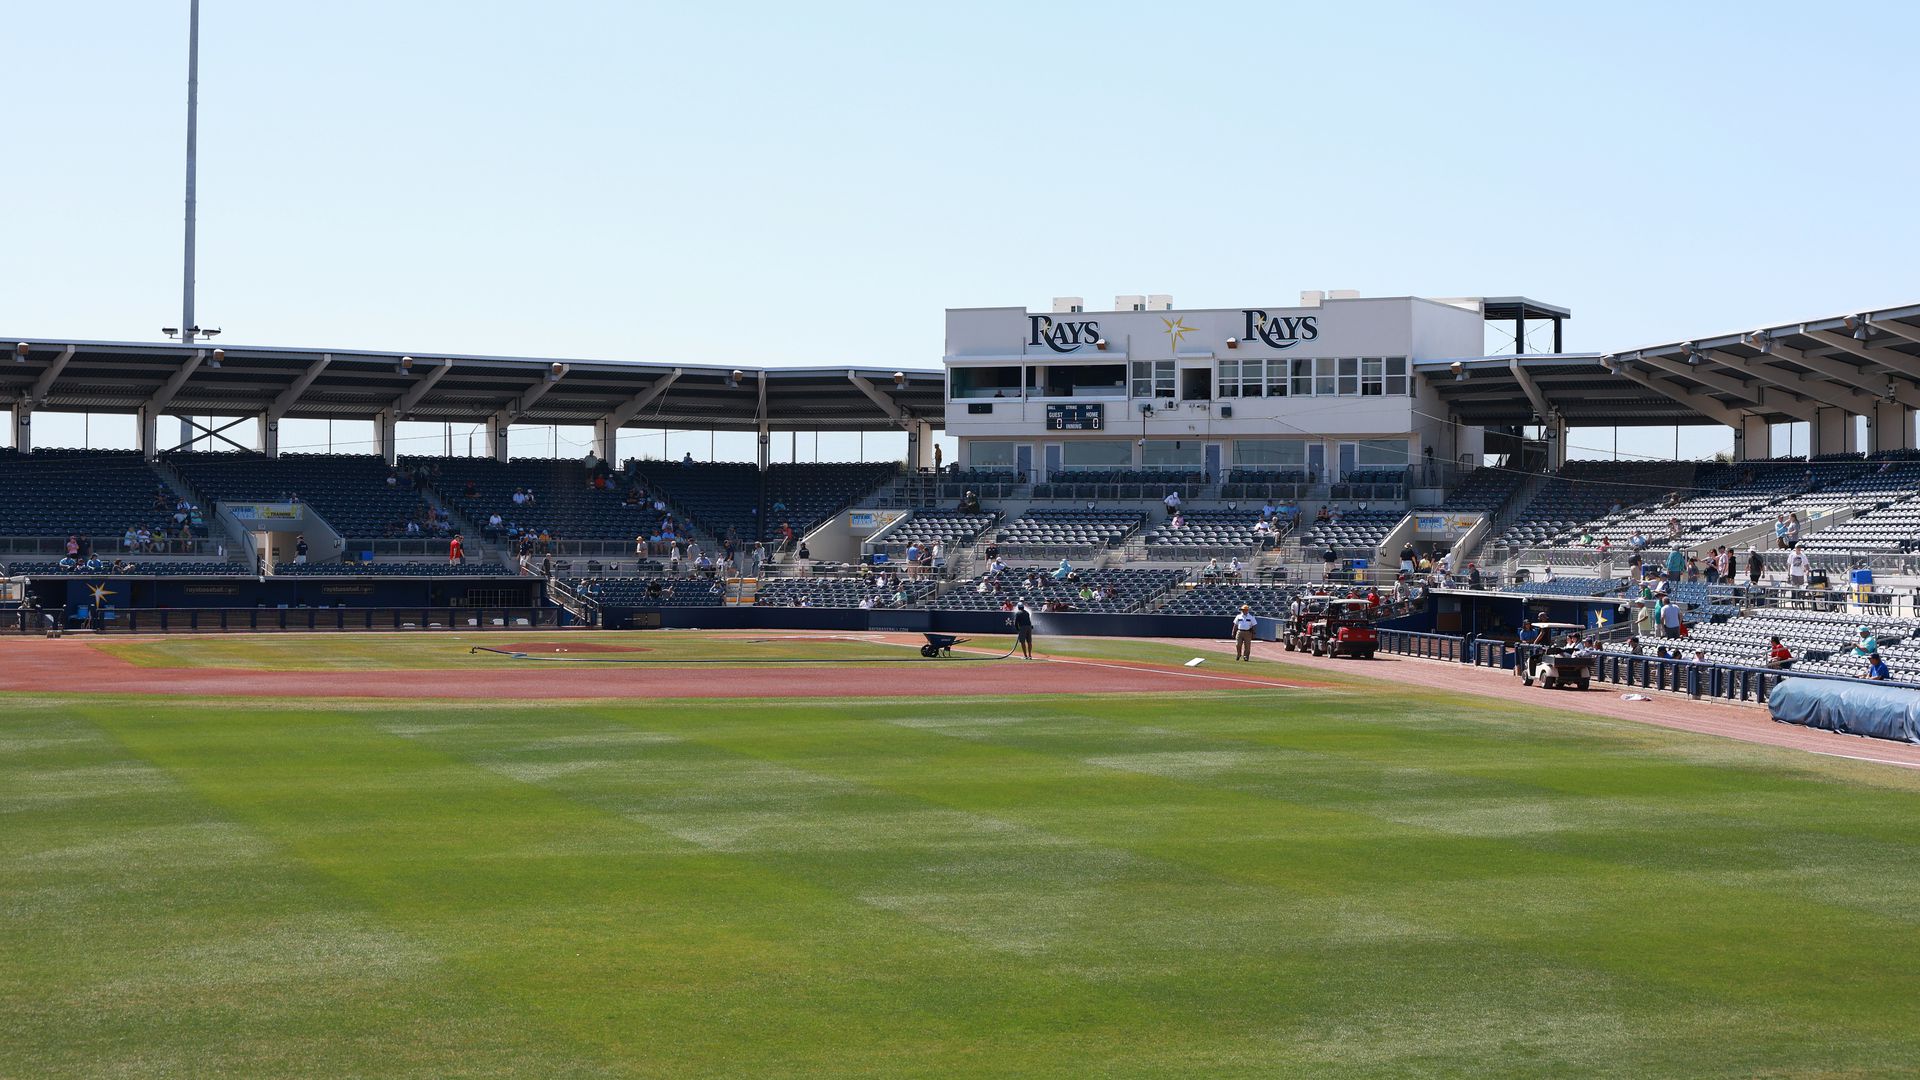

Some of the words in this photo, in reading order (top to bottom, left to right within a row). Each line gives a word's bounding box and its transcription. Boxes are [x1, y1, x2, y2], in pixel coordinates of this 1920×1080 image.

[1028, 315, 1100, 353] RAYS
[1242, 310, 1318, 349] RAYS
[1056, 418, 1062, 428] 0
[1092, 418, 1098, 428] 0
